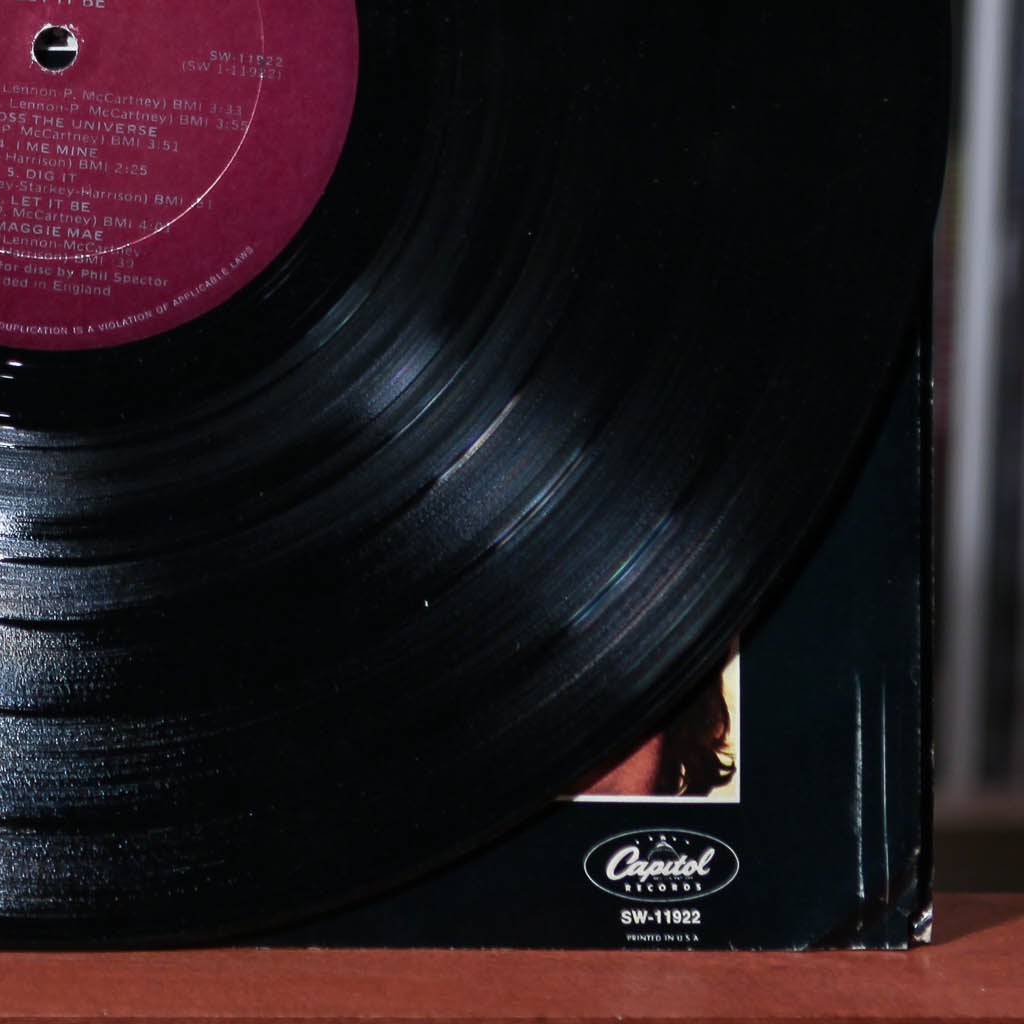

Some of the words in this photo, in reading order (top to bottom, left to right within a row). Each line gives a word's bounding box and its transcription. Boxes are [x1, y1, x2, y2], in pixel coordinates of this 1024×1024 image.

[82, 89, 167, 110] McCartney)
[172, 98, 202, 113] BMI
[32, 114, 65, 129] THE
[72, 118, 158, 138] UNIVERSE
[89, 104, 174, 124] McCartney)
[179, 114, 209, 127] BMI
[21, 126, 105, 145] McCartney)
[111, 135, 140, 148] BMI
[16, 140, 20, 150] I
[26, 141, 50, 154] ME
[56, 143, 98, 158] MINE
[6, 153, 72, 169] Harrison)
[79, 159, 108, 171] BMI
[114, 164, 148, 176] 2:25
[7, 167, 19, 178] 5.
[25, 168, 55, 182] DIG
[62, 172, 77, 183] IT
[11, 195, 42, 208] LET
[48, 198, 63, 209] IT
[70, 201, 91, 213] BE
[154, 194, 184, 206] BMI
[12, 207, 97, 227] McCartney)
[103, 216, 132, 229] BMI
[67, 227, 103, 242] MAE
[24, 263, 51, 276] disc
[56, 266, 74, 278] by
[80, 268, 108, 281] Phil
[113, 272, 169, 288] Spector
[34, 281, 47, 290] in
[52, 280, 112, 297] England
[72, 326, 84, 335] IS
[87, 325, 95, 334] A
[98, 310, 153, 332] VIOLATION
[155, 302, 170, 314] OF
[172, 266, 230, 308] APPLICABLE
[229, 245, 255, 270] LAWS
[605, 845, 716, 883] Capitol
[624, 881, 703, 892] RECORDS
[620, 909, 702, 925] SW-11922
